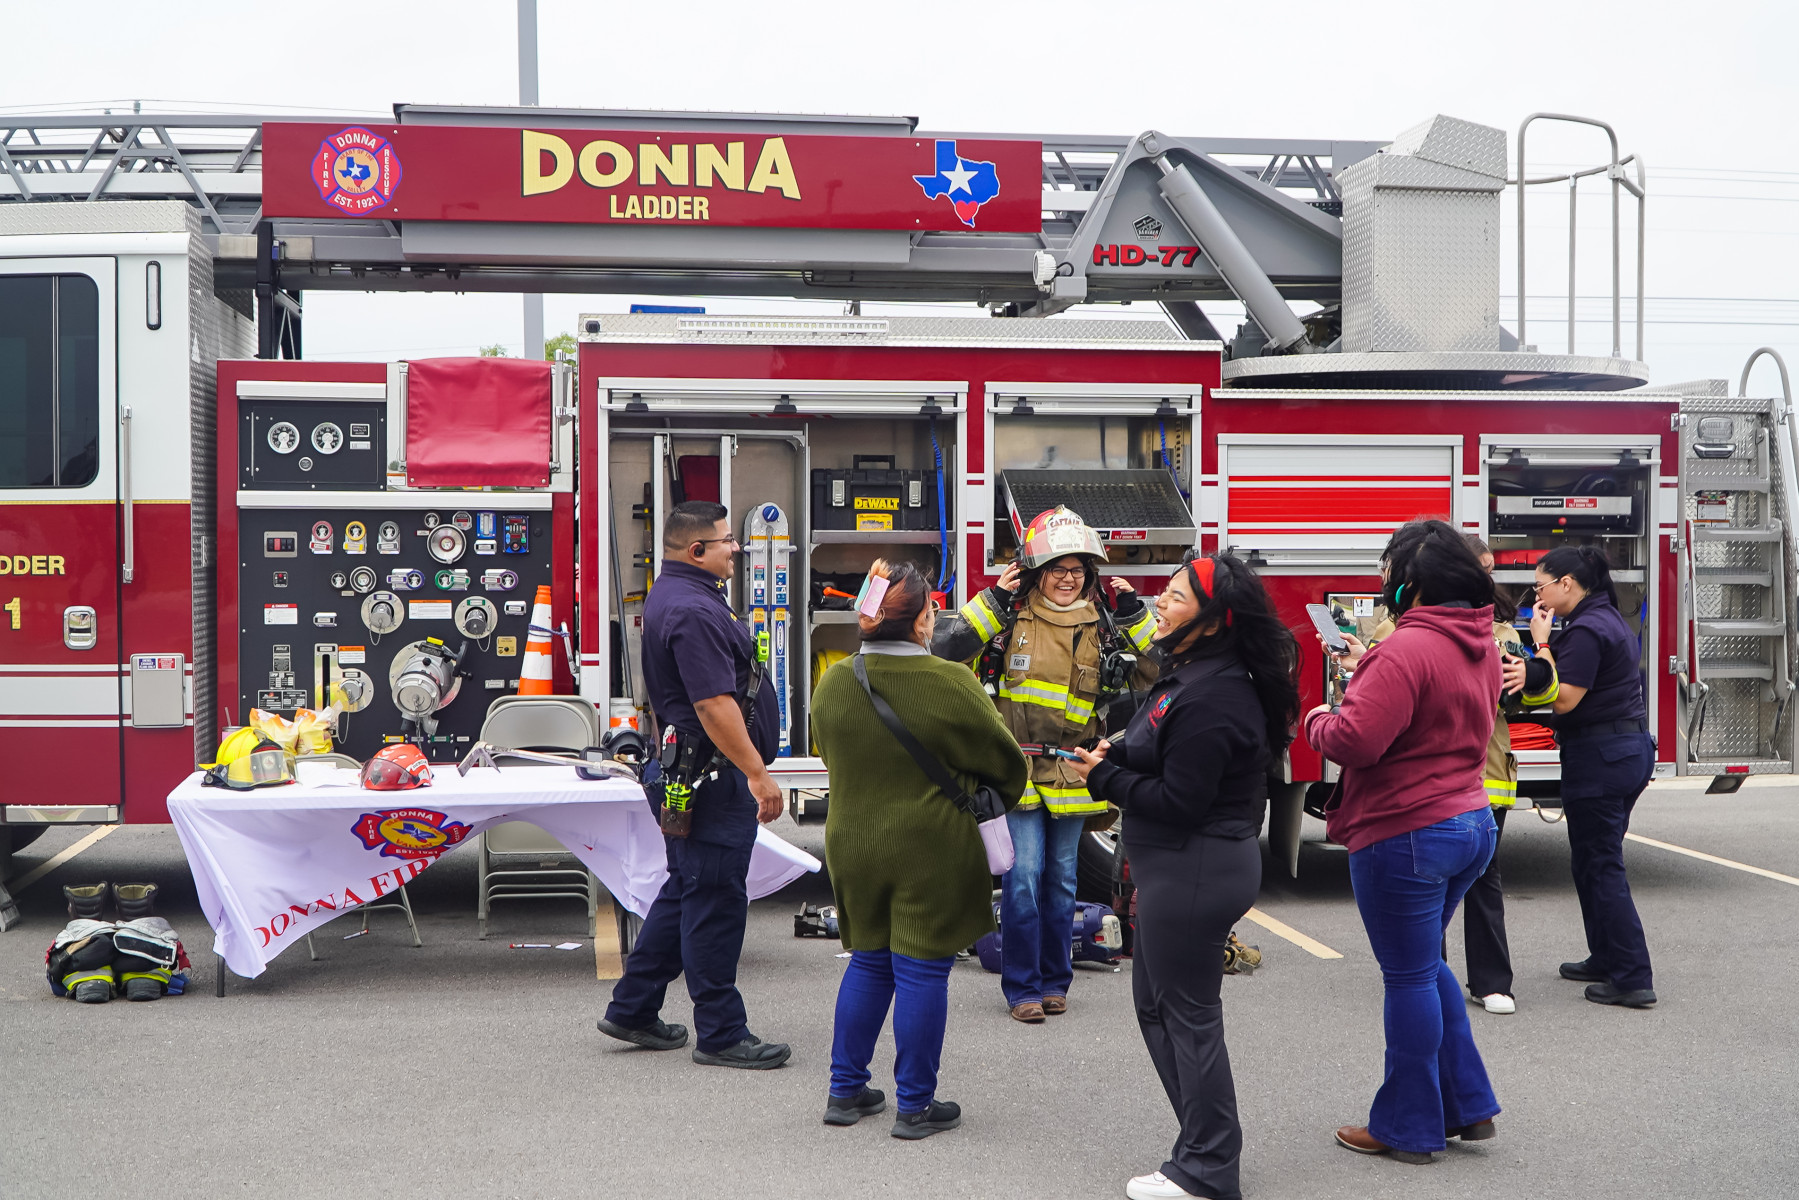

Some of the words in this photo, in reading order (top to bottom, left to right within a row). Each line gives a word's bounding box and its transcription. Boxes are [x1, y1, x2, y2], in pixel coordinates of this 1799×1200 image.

[336, 133, 376, 148] DONNA
[521, 129, 801, 199] DONNA
[334, 193, 353, 208] EST.
[356, 195, 378, 208] 1921
[610, 194, 710, 220] LADDER
[1093, 243, 1201, 267] HD-77
[1050, 518, 1080, 528] CAPTAIN
[4, 597, 21, 630] 1
[390, 810, 433, 821] DONNA
[367, 820, 375, 839] FIRE
